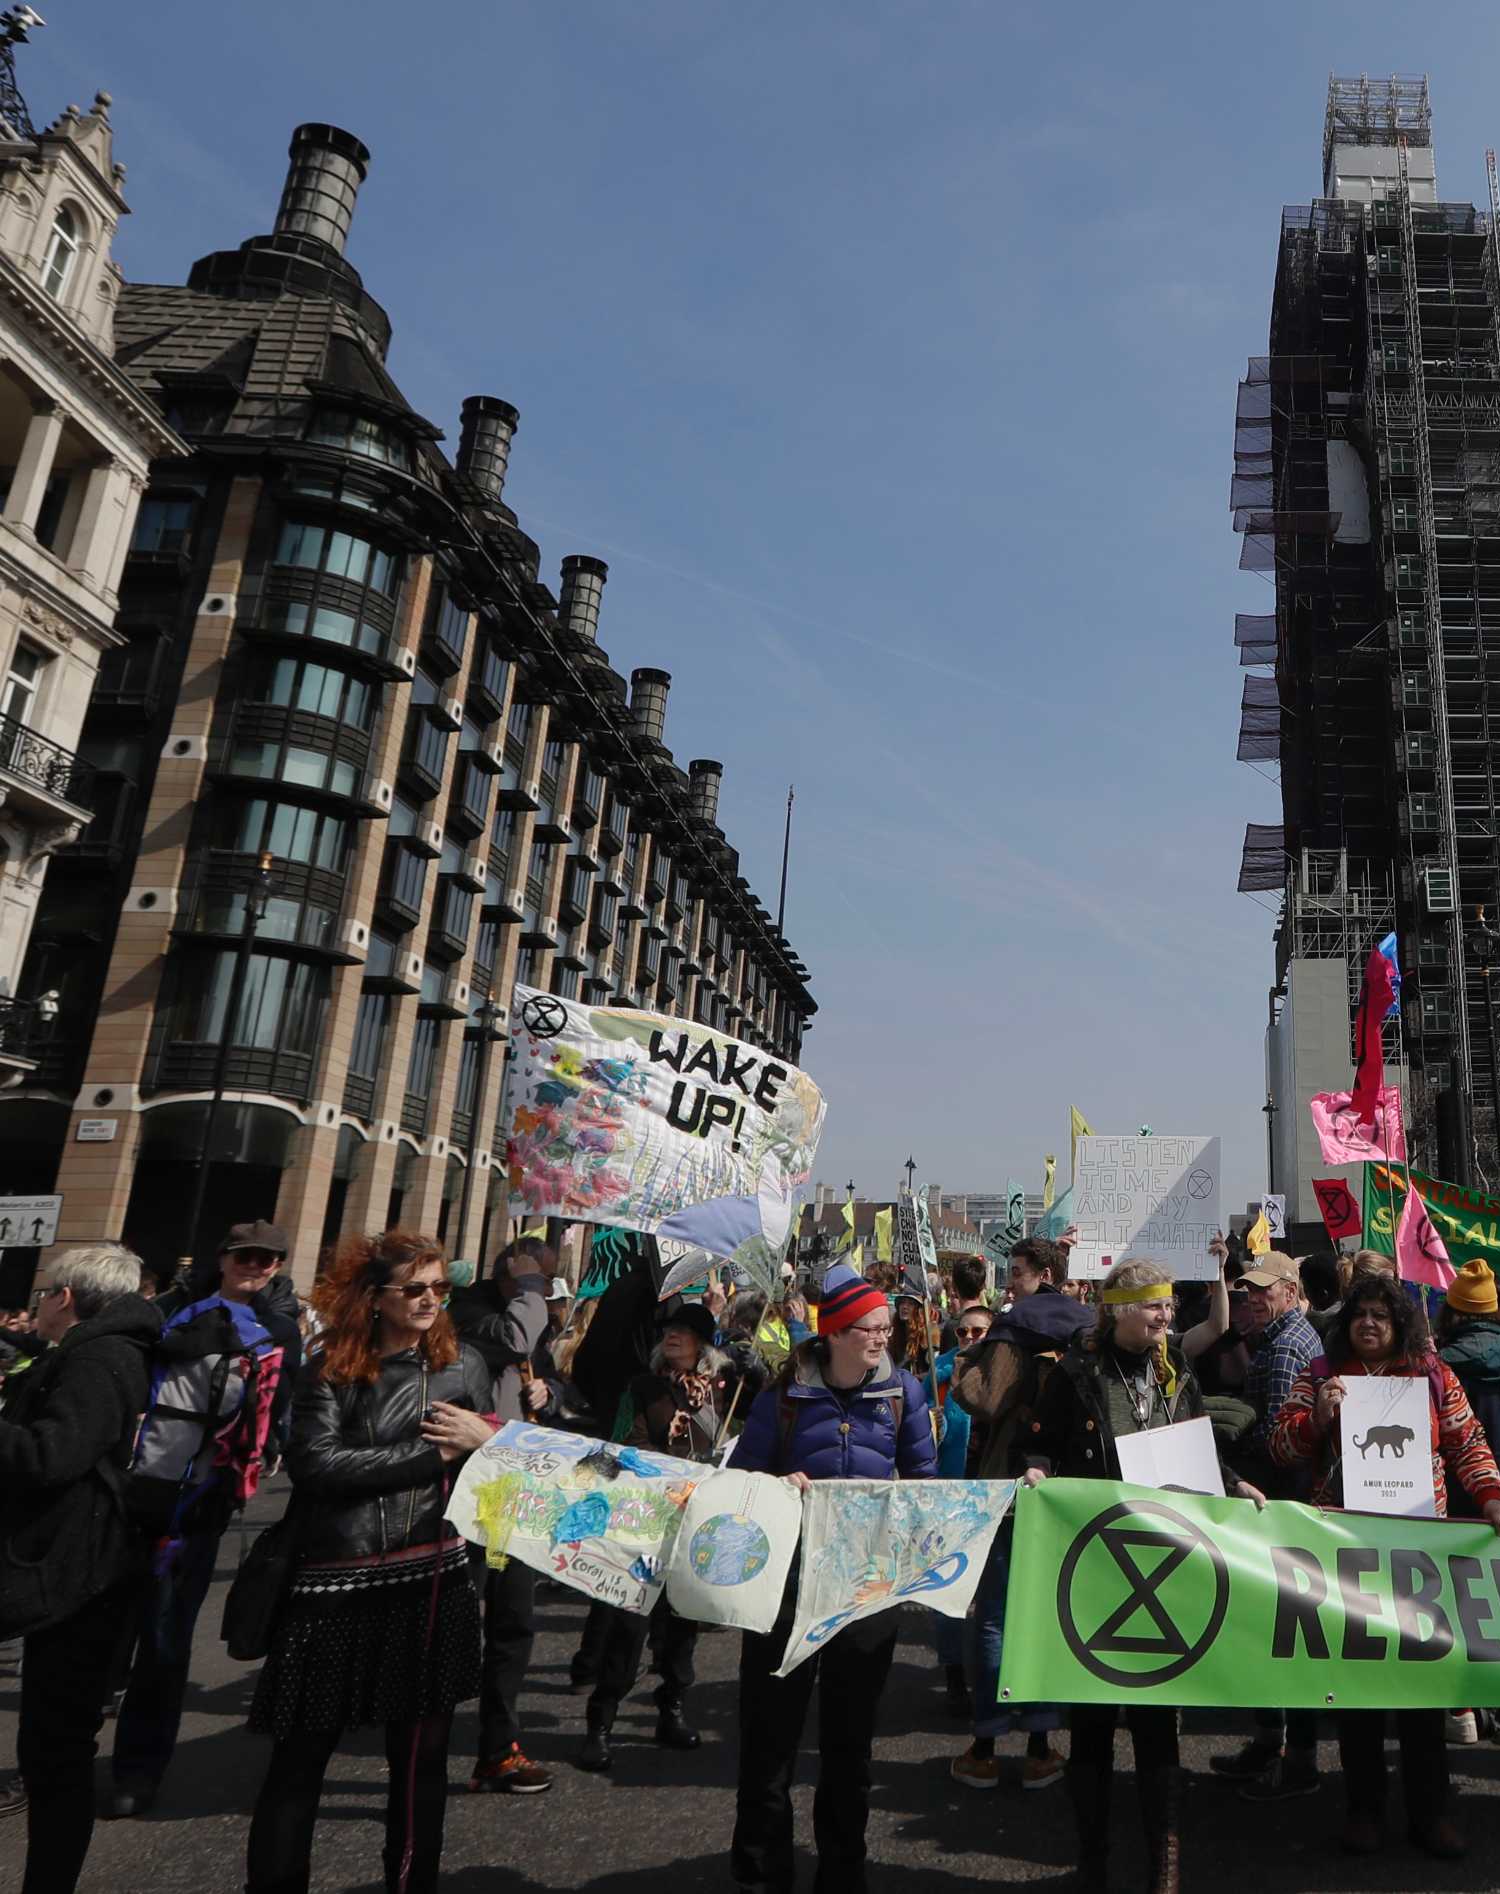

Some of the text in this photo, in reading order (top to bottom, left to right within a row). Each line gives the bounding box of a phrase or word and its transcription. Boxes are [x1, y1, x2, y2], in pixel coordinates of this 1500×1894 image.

[649, 1030, 787, 1113] WAKE
[666, 1080, 746, 1153] UP!
[1079, 1138, 1197, 1169] LISTEN
[1080, 1169, 1169, 1193] TO ME
[1077, 1191, 1133, 1215] AND
[1384, 1479, 1414, 1489] LEOPARD
[595, 1578, 628, 1607] dying
